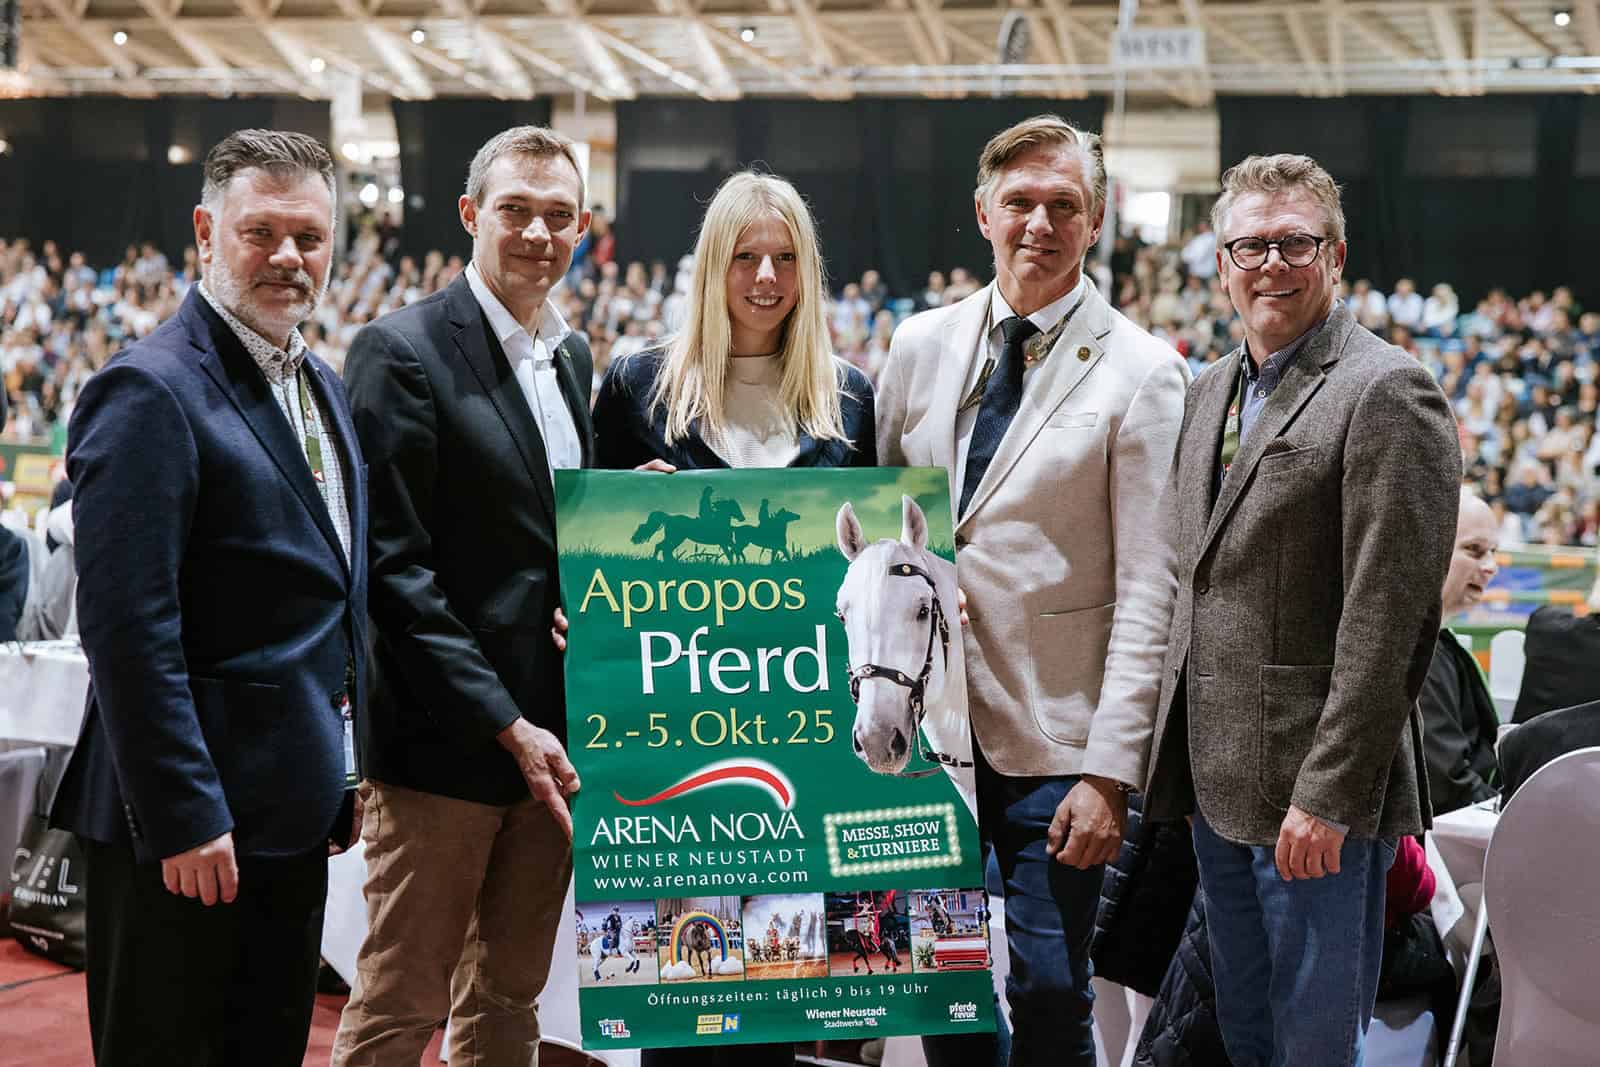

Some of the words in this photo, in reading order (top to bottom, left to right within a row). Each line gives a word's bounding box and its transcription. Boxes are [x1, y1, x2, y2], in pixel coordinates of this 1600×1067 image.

[579, 568, 806, 628] Apropos
[639, 624, 830, 694] Pferd
[591, 814, 701, 845] ARENA
[711, 811, 805, 842] NOVA
[591, 852, 680, 869] WIENER
[689, 848, 806, 866] NEUSTADT
[593, 870, 808, 889] www.arenanova.com
[647, 990, 769, 1007] Öffnungszeiten:
[776, 986, 828, 1002] täglich
[835, 986, 843, 998] 9
[850, 985, 872, 997] bis
[880, 984, 895, 996] 19
[903, 983, 929, 995] Uhr
[805, 1007, 842, 1020] Wiener
[842, 1005, 887, 1018] Neustadt
[949, 1001, 977, 1015] pferde
